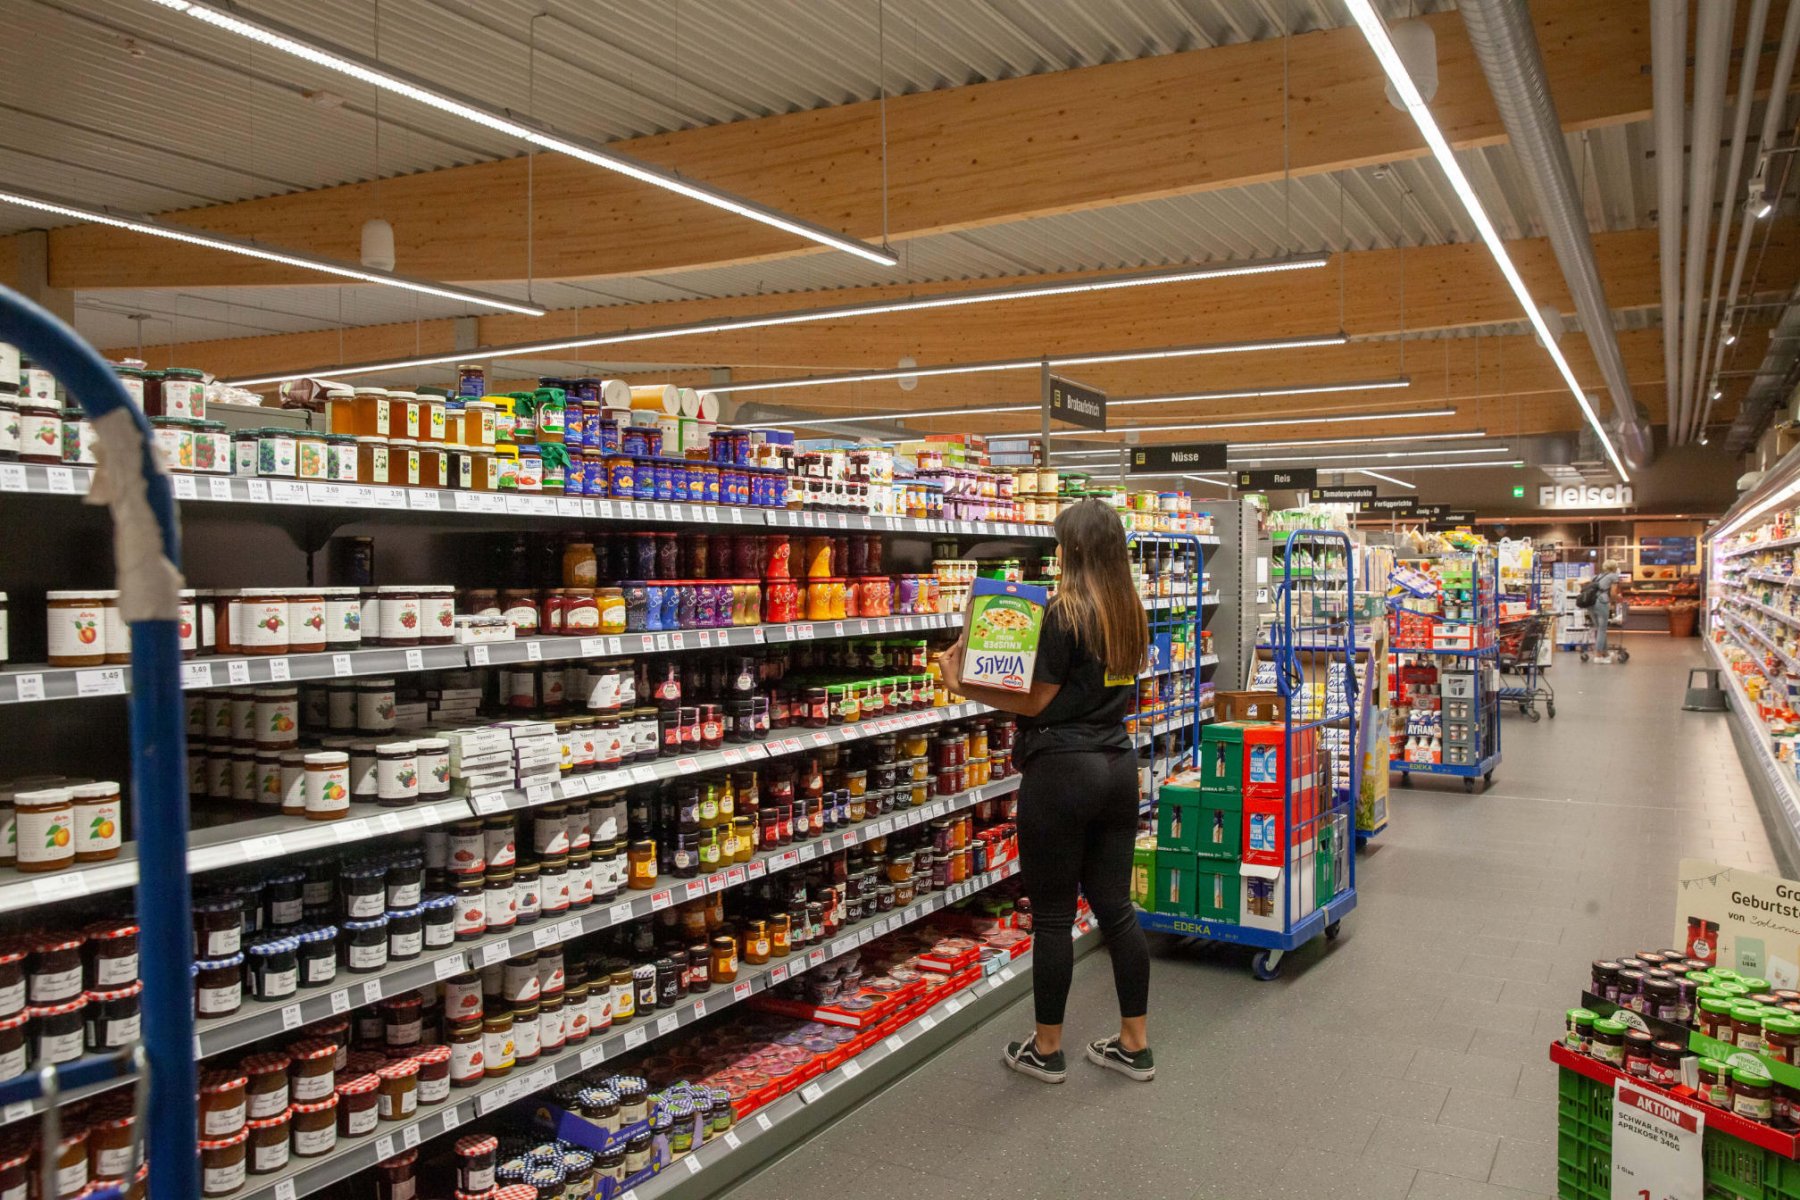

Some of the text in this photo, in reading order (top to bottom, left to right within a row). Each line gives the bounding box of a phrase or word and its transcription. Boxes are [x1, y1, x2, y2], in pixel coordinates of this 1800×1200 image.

[1067, 395, 1100, 417] Brotaufstrich
[1171, 452, 1199, 463] Nüsse
[1274, 474, 1291, 483] Reis
[1323, 490, 1373, 498] Tomatenprodukte
[1539, 484, 1633, 506] Fleisch
[983, 640, 1022, 649] KNUSPER
[192, 666, 207, 674] 3,49
[974, 655, 1025, 676] VITALIS
[102, 672, 119, 681] 3,49
[1408, 724, 1434, 735] AYRAN
[1732, 891, 1800, 919] Geburtst
[1728, 912, 1745, 922] von
[1173, 921, 1211, 936] EDEKA
[1619, 1012, 1643, 1027] Extra
[1637, 1095, 1680, 1124] AKTION
[1618, 1121, 1680, 1152] APRIKOSE 340G
[1621, 1166, 1634, 1176] Glas
